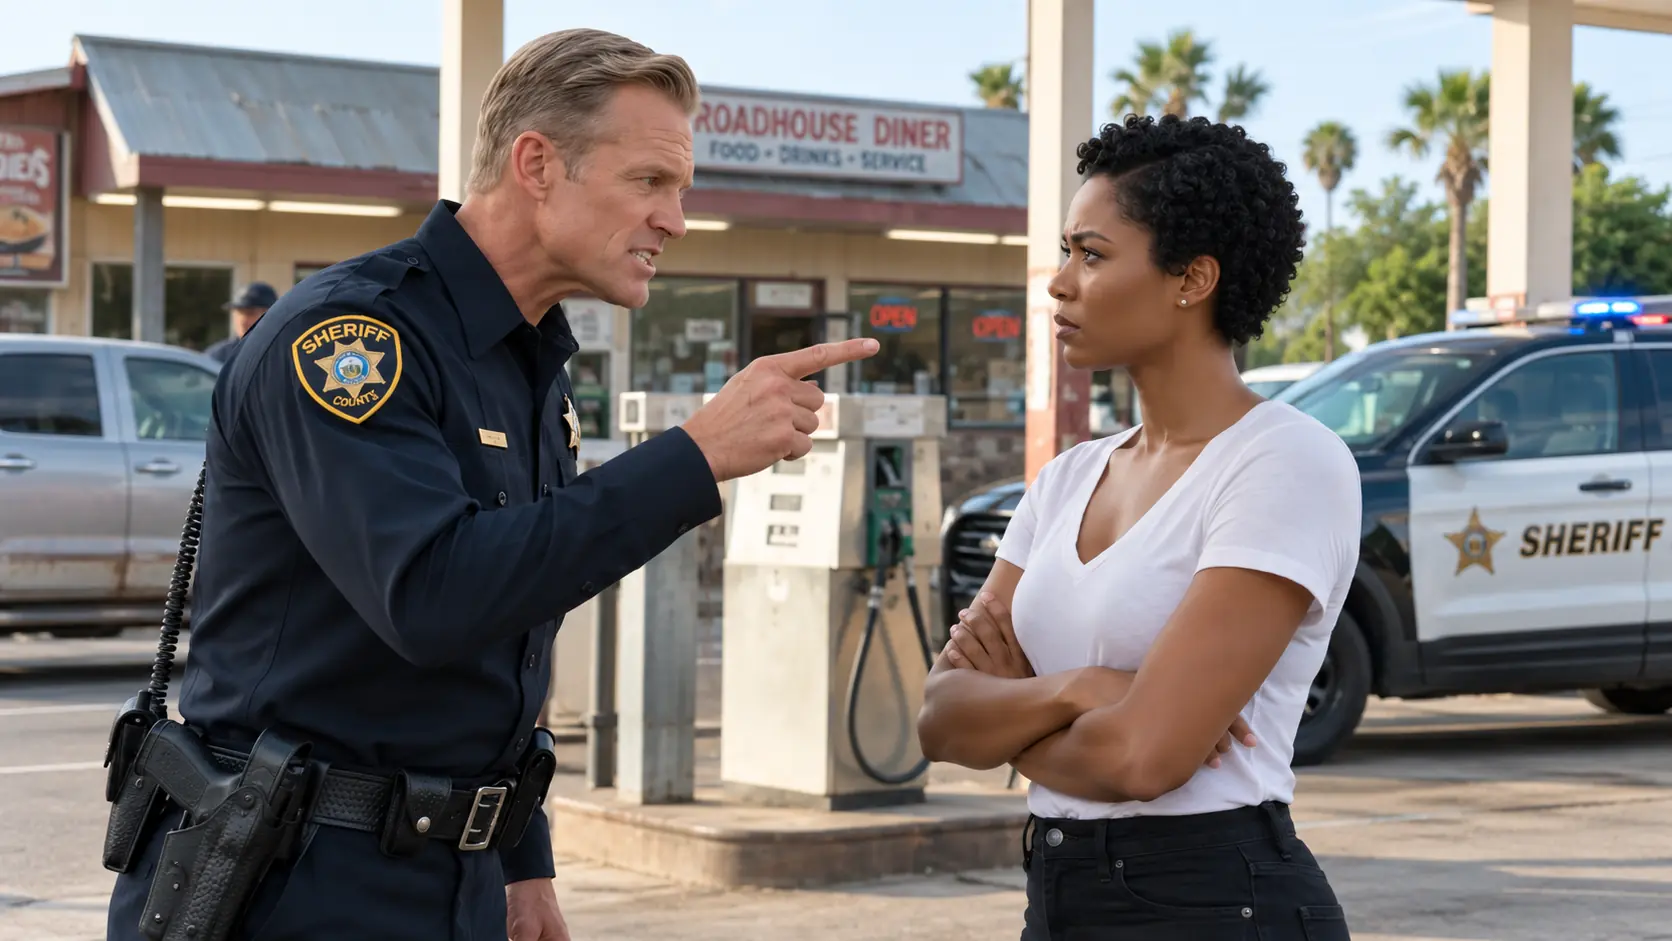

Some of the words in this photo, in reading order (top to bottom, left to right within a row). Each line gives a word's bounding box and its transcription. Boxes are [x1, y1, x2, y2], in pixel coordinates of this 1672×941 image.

[694, 101, 858, 144] ROADHOUSE
[873, 115, 951, 150] DINER
[709, 140, 760, 163] FOOD
[779, 145, 842, 168] DRINKS
[860, 151, 927, 173] SERVICE
[870, 305, 918, 328] OPEN
[972, 315, 1021, 338] OPEN
[301, 323, 391, 355] SHERIFF
[1518, 517, 1665, 559] SHERIFF
